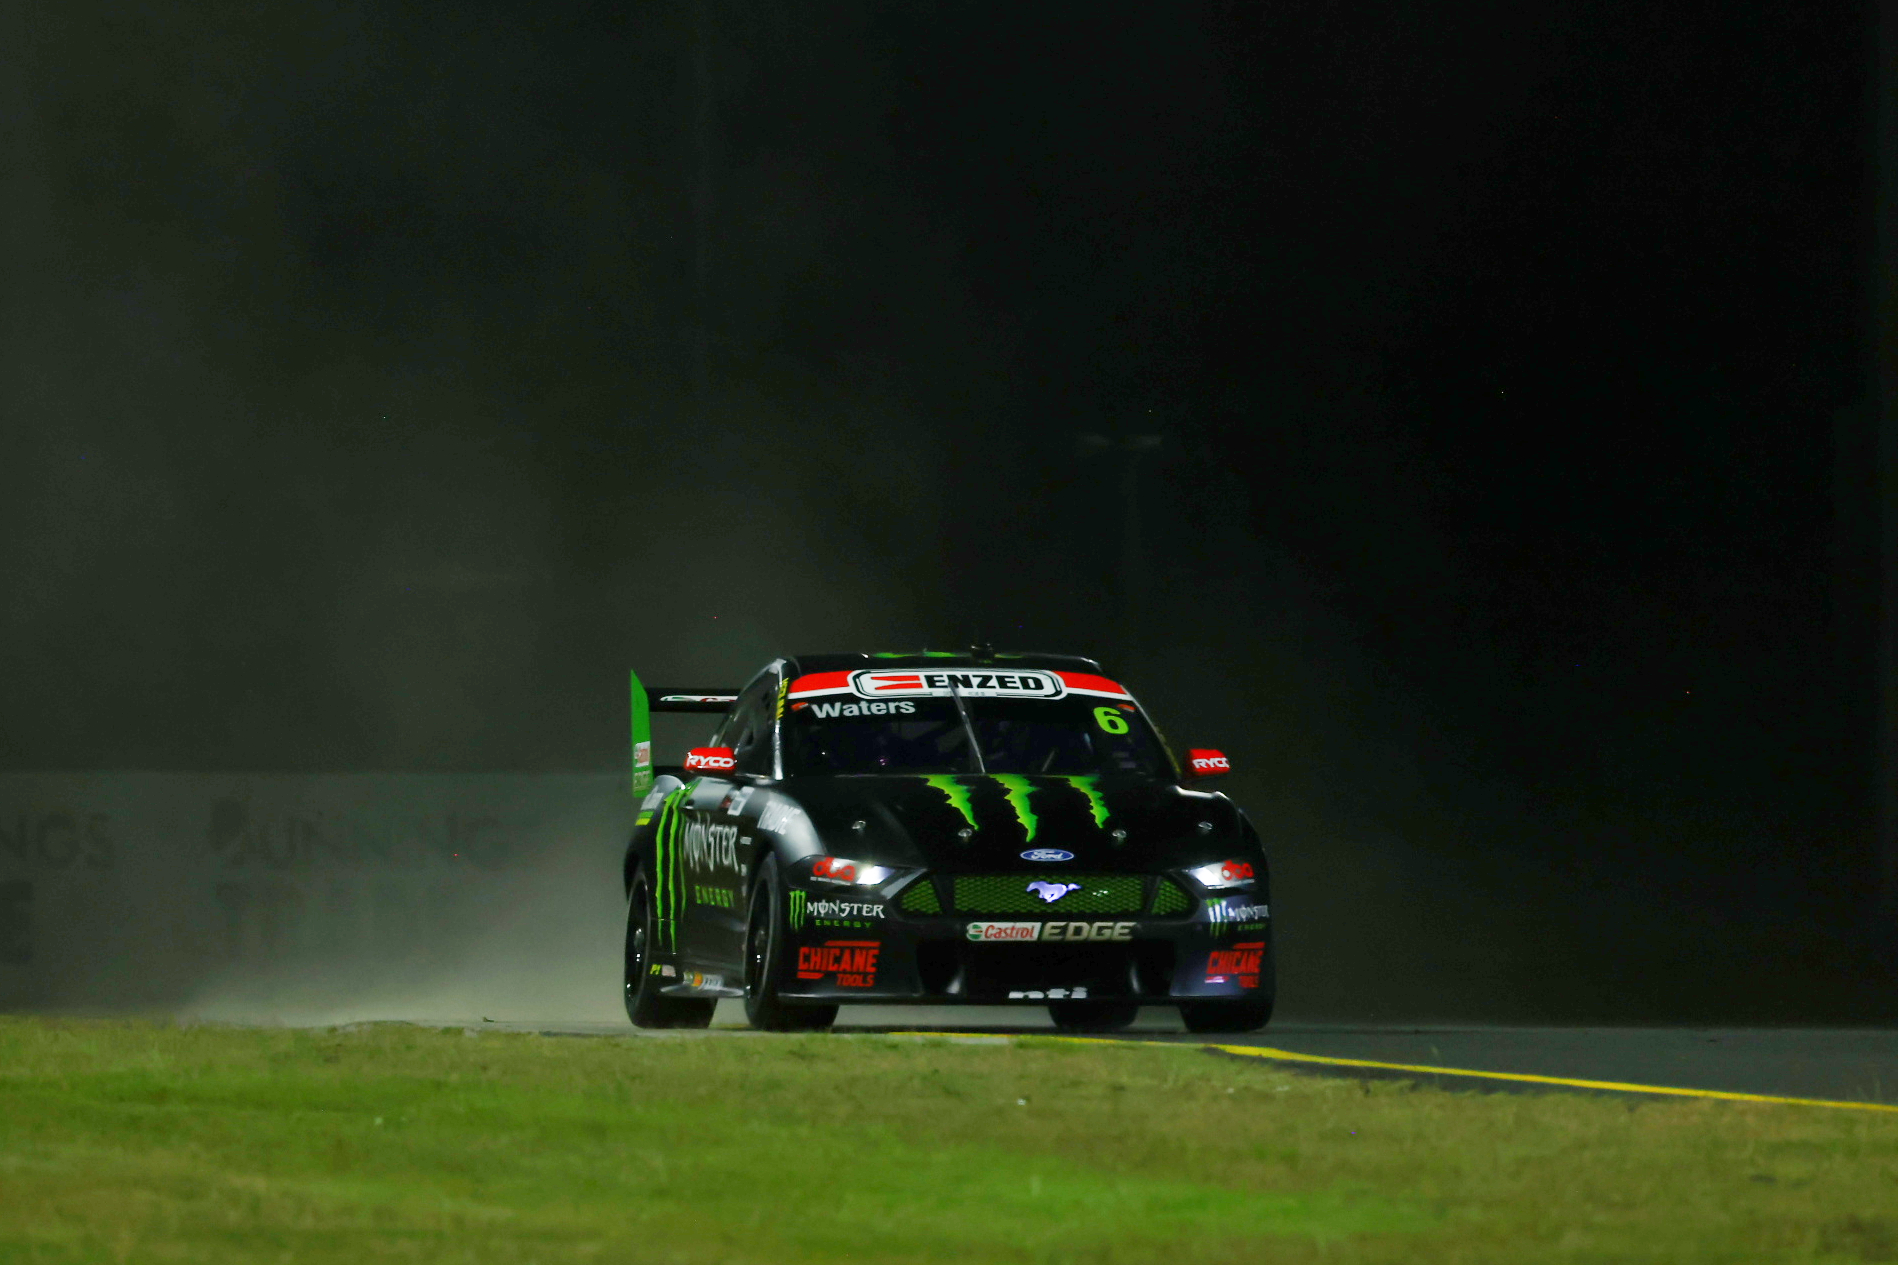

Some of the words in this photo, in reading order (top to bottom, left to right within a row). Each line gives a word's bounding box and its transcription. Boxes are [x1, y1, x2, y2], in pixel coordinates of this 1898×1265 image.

[924, 675, 1044, 690] ENZED
[811, 701, 916, 718] Waters
[1094, 707, 1129, 734] 6
[686, 755, 734, 767] RYCO
[1192, 757, 1230, 768] RYC
[684, 811, 738, 874] MONSTER
[807, 900, 884, 918] MONSTER
[984, 924, 1035, 939] Castrol
[1042, 922, 1137, 941] EDGE
[798, 946, 880, 973] CHICANE
[836, 973, 875, 988] TOOLS
